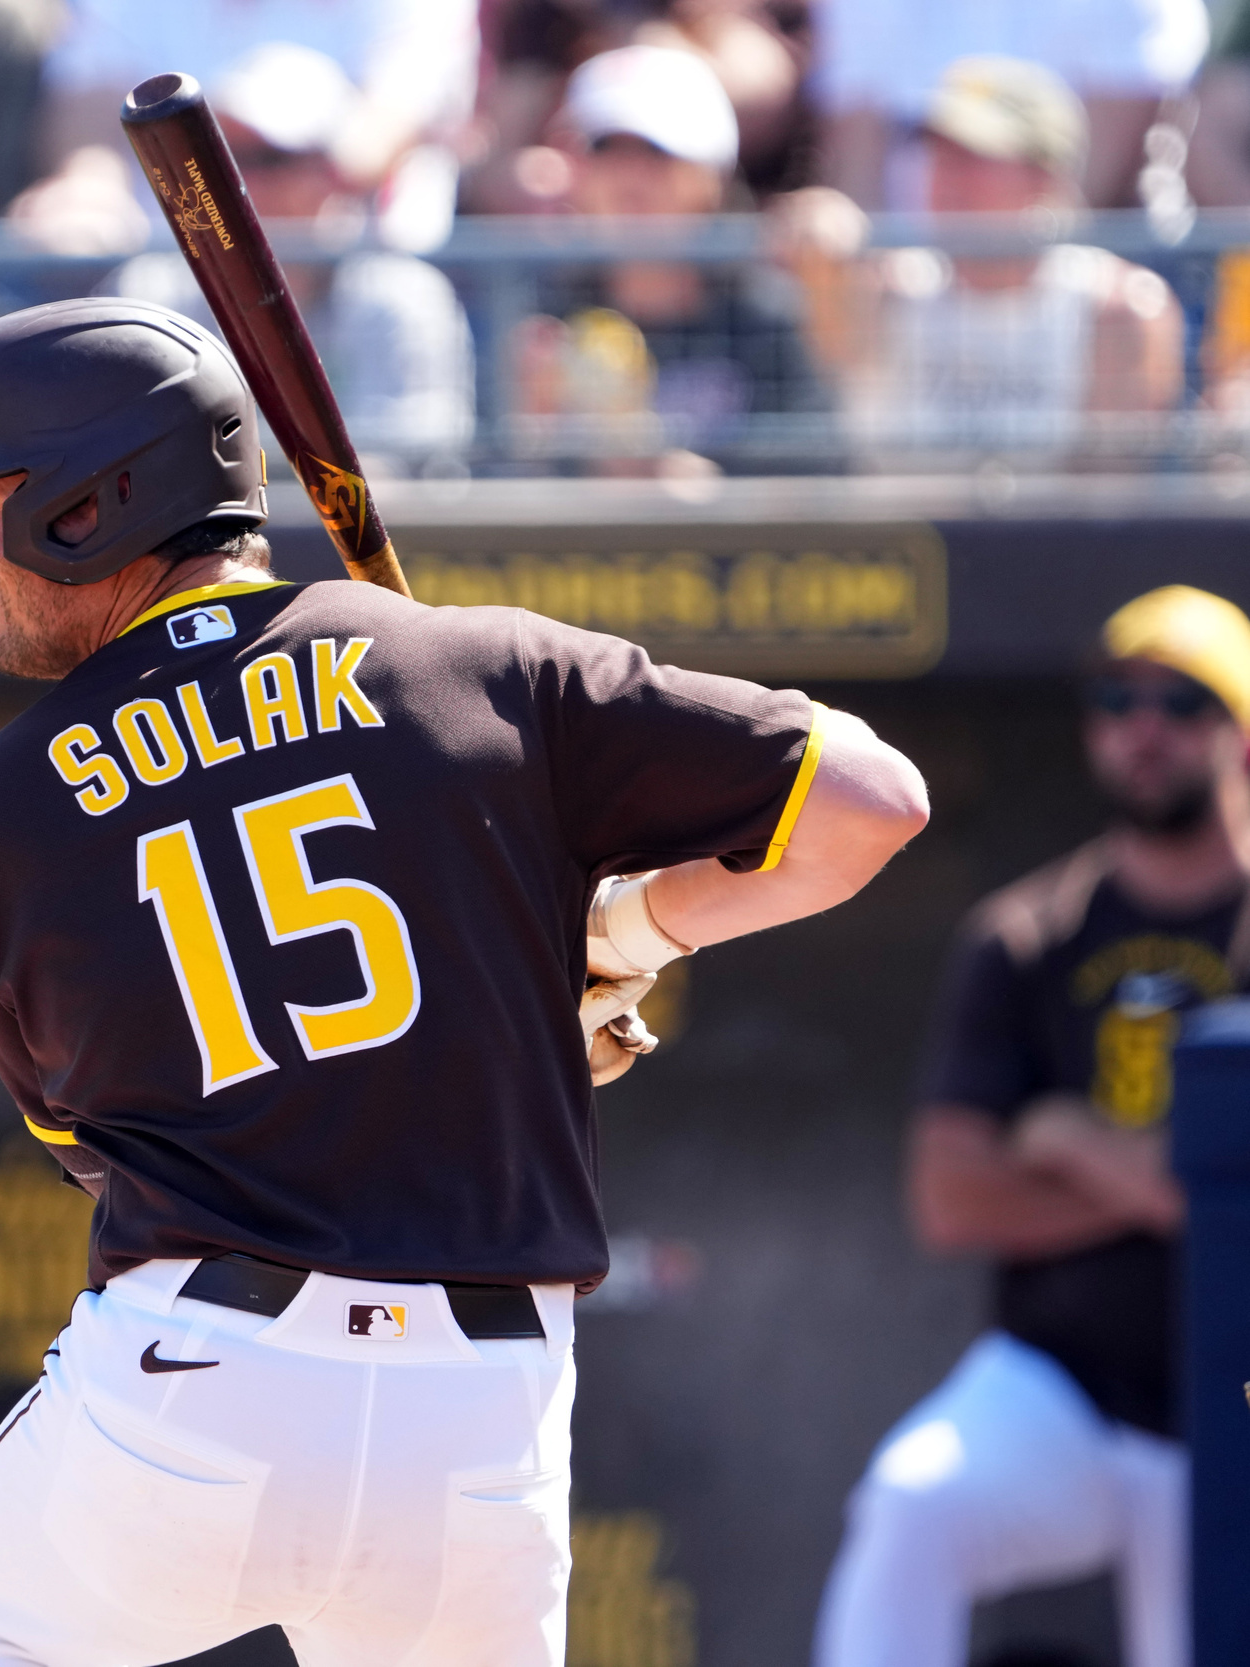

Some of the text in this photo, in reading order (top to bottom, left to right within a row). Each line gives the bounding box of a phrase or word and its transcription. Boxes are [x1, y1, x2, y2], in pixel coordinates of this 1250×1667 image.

[184, 157, 208, 193] MAPLE
[200, 191, 235, 251] POWERIZED
[48, 637, 386, 817] SOLAK
[137, 772, 422, 1098] 15
